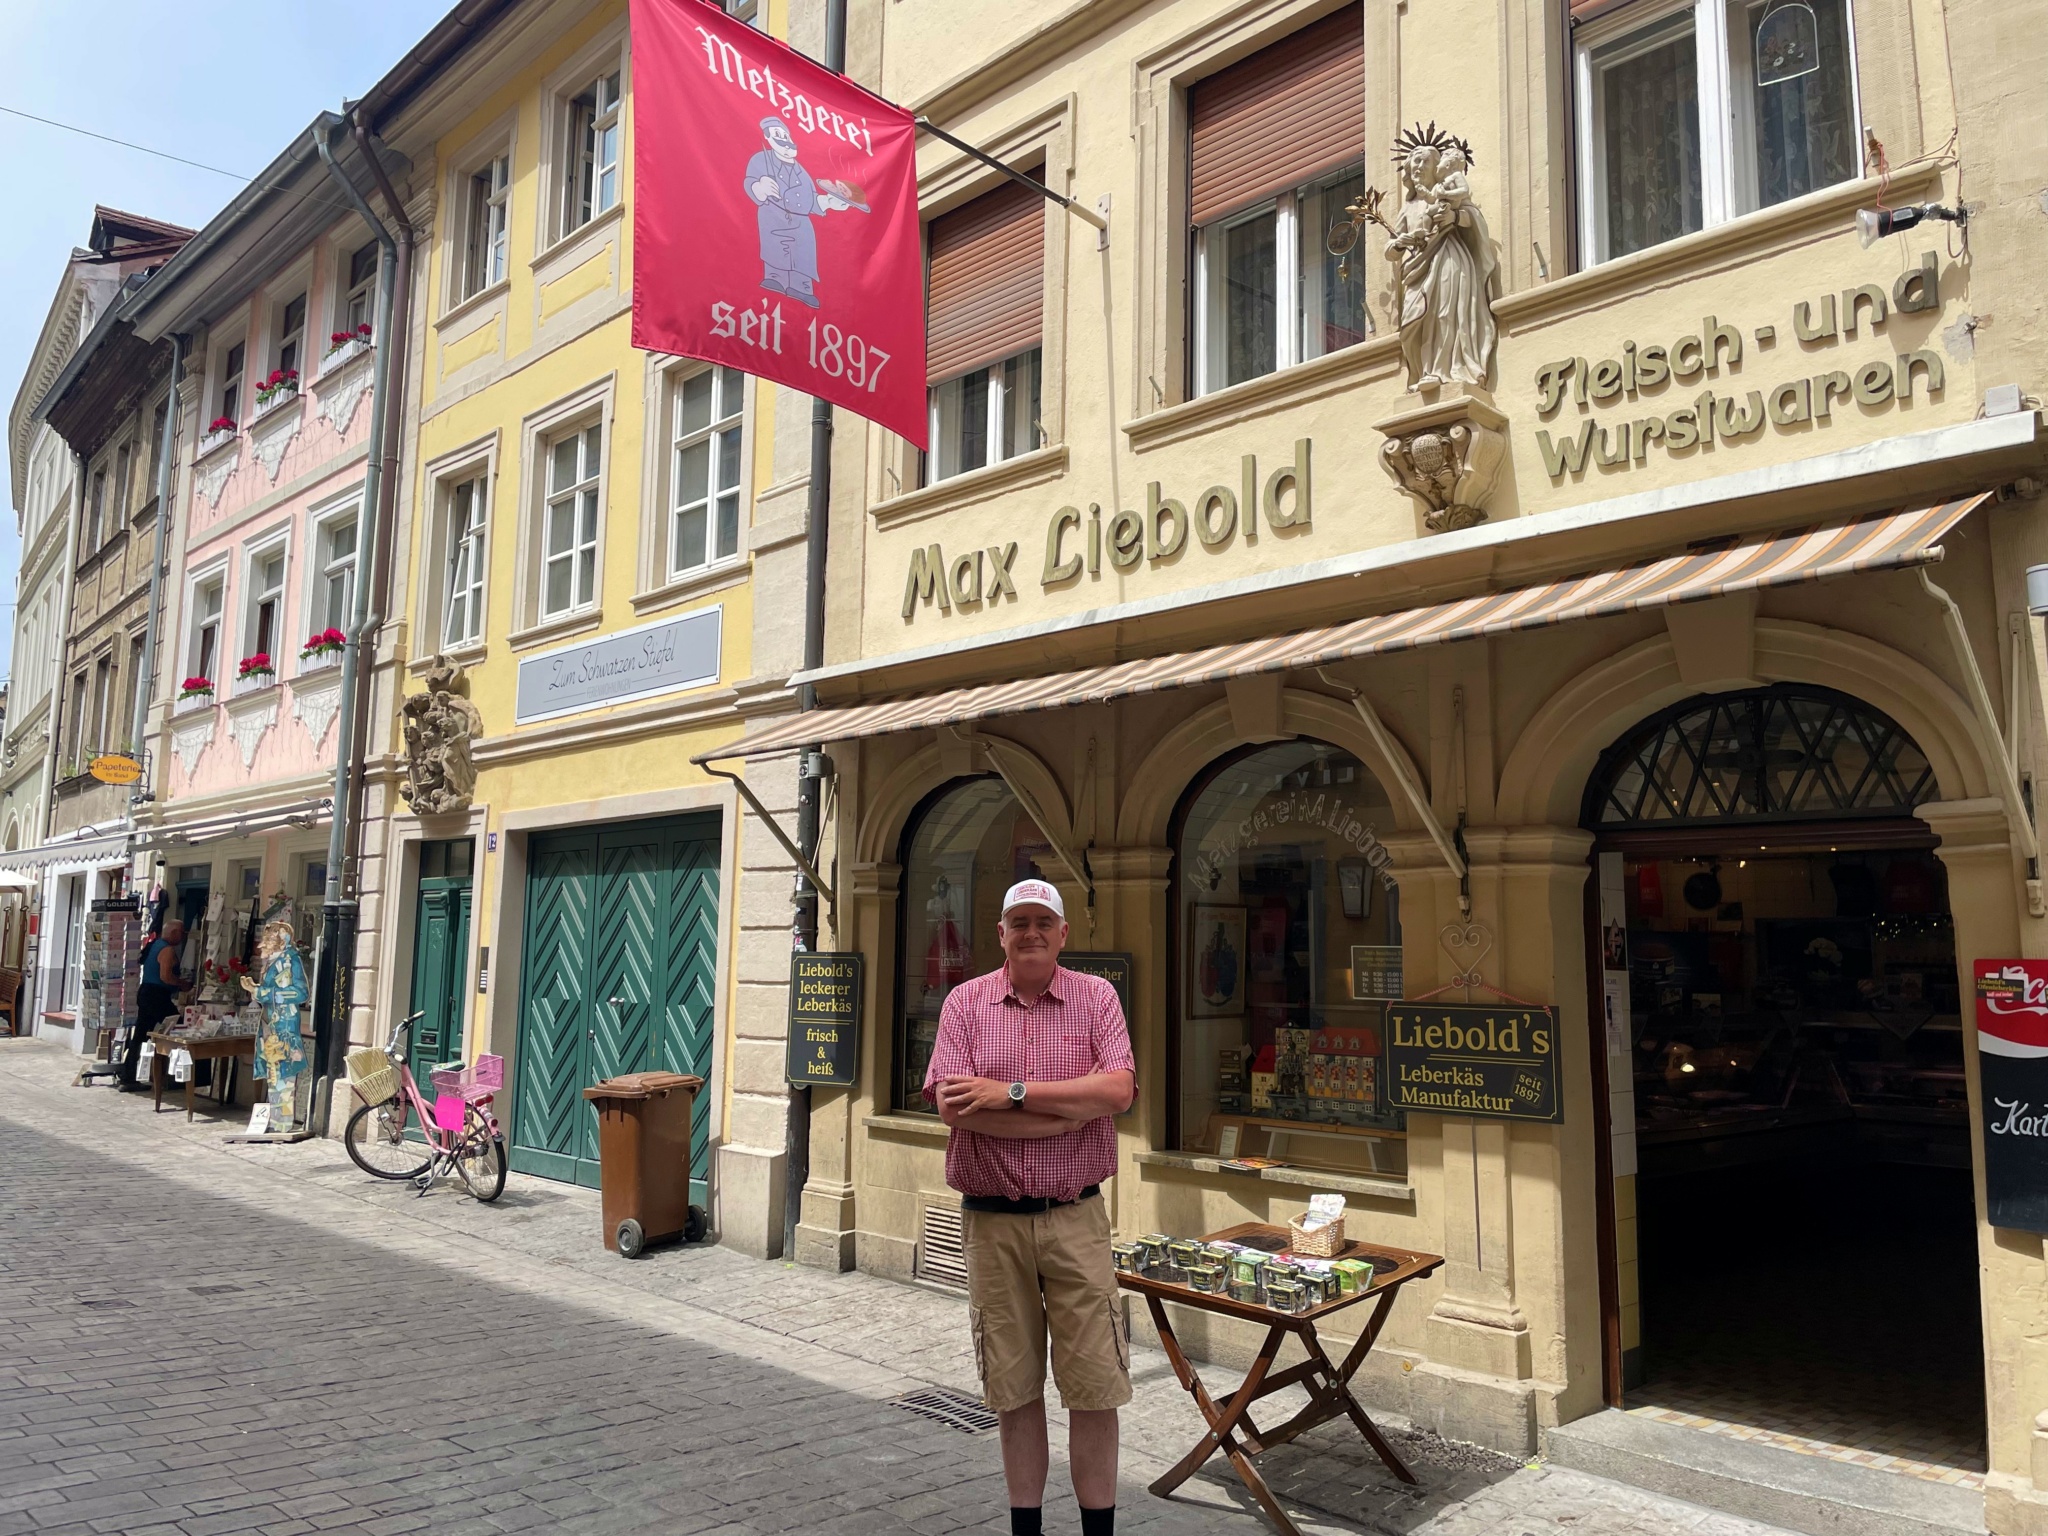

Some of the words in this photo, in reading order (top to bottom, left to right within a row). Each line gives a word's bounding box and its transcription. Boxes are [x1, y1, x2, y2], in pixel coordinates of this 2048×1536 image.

[695, 26, 874, 157] Metzgerei
[1794, 251, 1940, 343] und
[709, 297, 786, 356] seit
[807, 316, 891, 392] 1897
[1535, 350, 1944, 478] Wurstwaren
[902, 541, 1018, 618] Max
[1041, 438, 1312, 586] Liebold
[549, 659, 576, 690] Zum
[577, 649, 636, 684] Schwarzen
[638, 627, 679, 673] Stiefel
[96, 761, 138, 773] Papeterie
[489, 835, 496, 849] 12
[799, 963, 853, 978] Liebold's
[800, 980, 851, 996] leckerer
[797, 997, 852, 1013] Leberkäs
[806, 1028, 839, 1043] frisch
[1393, 1013, 1549, 1054] Liebold's
[817, 1046, 826, 1059] &
[807, 1061, 834, 1076] heiß
[1400, 1064, 1484, 1087] Leberkäs
[1518, 1073, 1542, 1092] seit
[1401, 1086, 1514, 1112] Manufaktur
[1514, 1084, 1541, 1104] 1897
